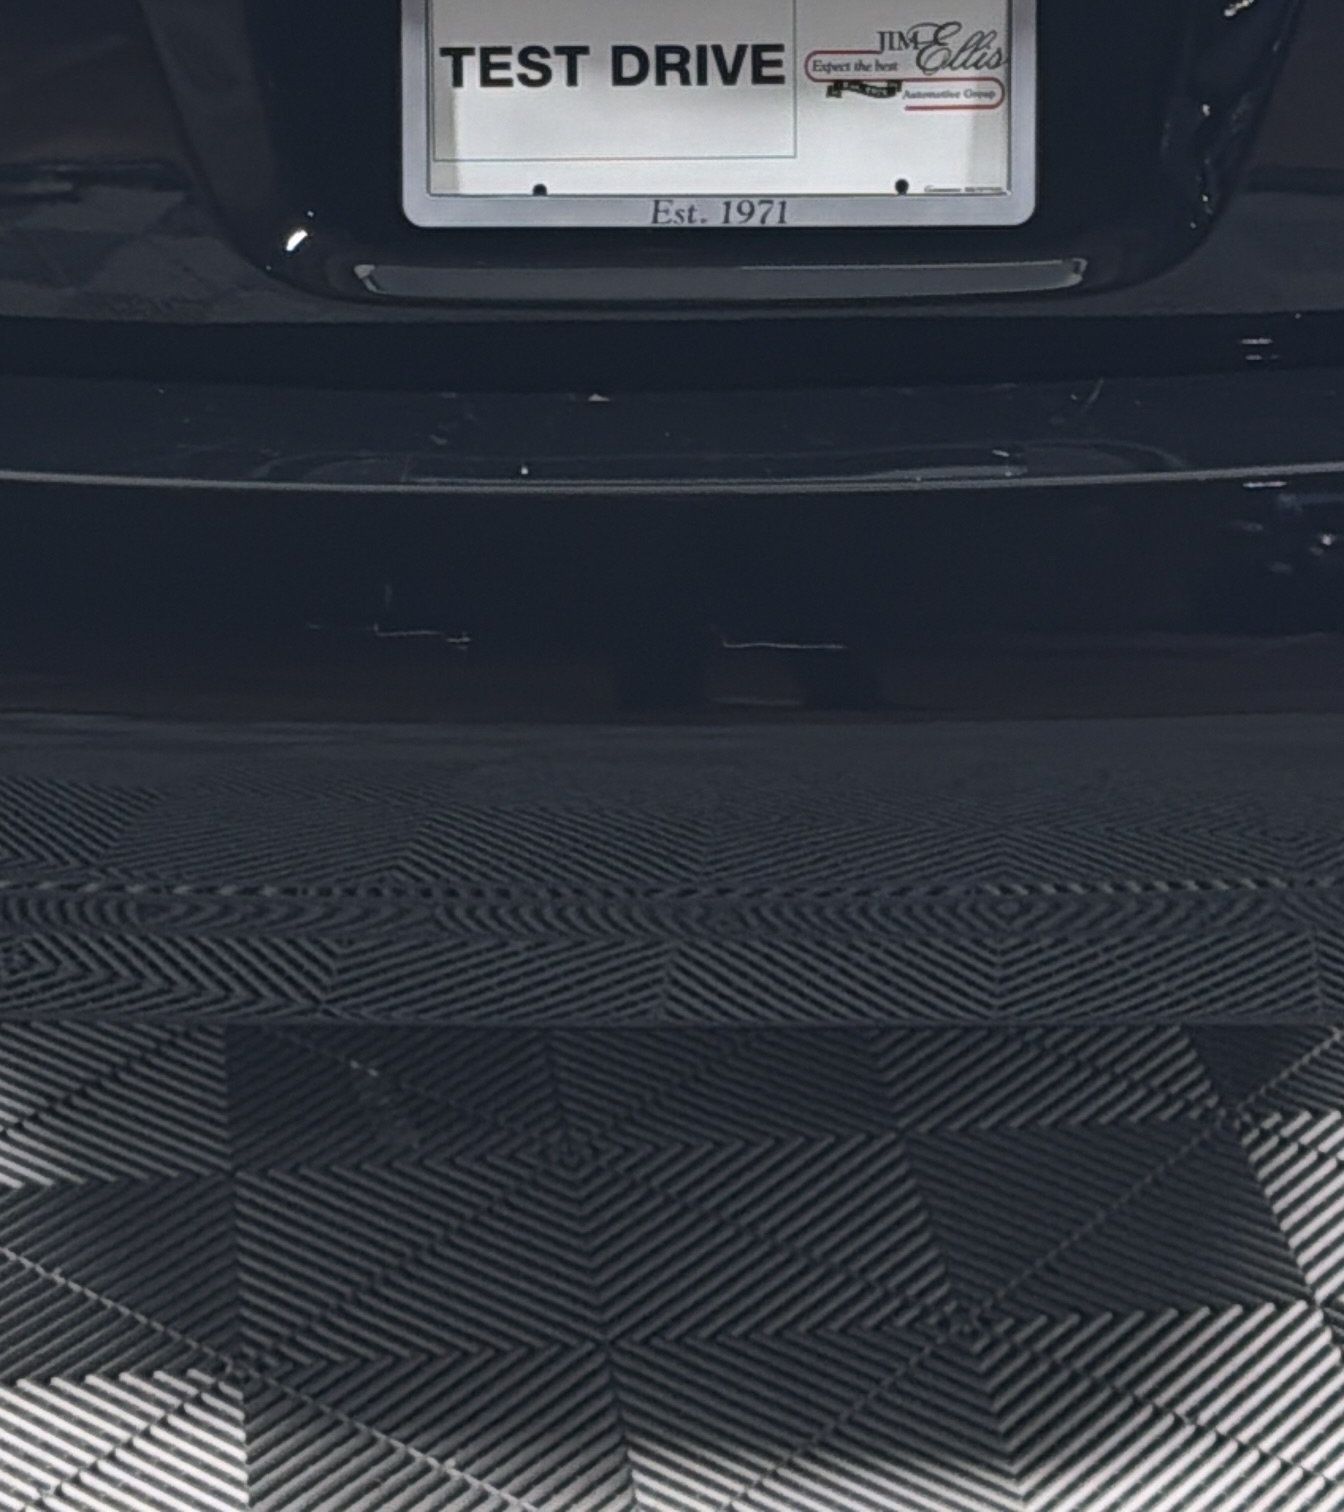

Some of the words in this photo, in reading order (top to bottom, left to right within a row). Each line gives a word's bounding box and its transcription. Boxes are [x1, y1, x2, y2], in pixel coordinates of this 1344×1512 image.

[439, 45, 590, 89] TEST
[610, 43, 786, 88] DRIVE
[812, 59, 851, 74] Expect
[854, 58, 872, 72] the
[874, 59, 899, 72] best
[877, 31, 921, 52] JIM
[906, 21, 1007, 76] Ellis
[650, 199, 708, 225] Est.
[720, 199, 789, 225] 1971
